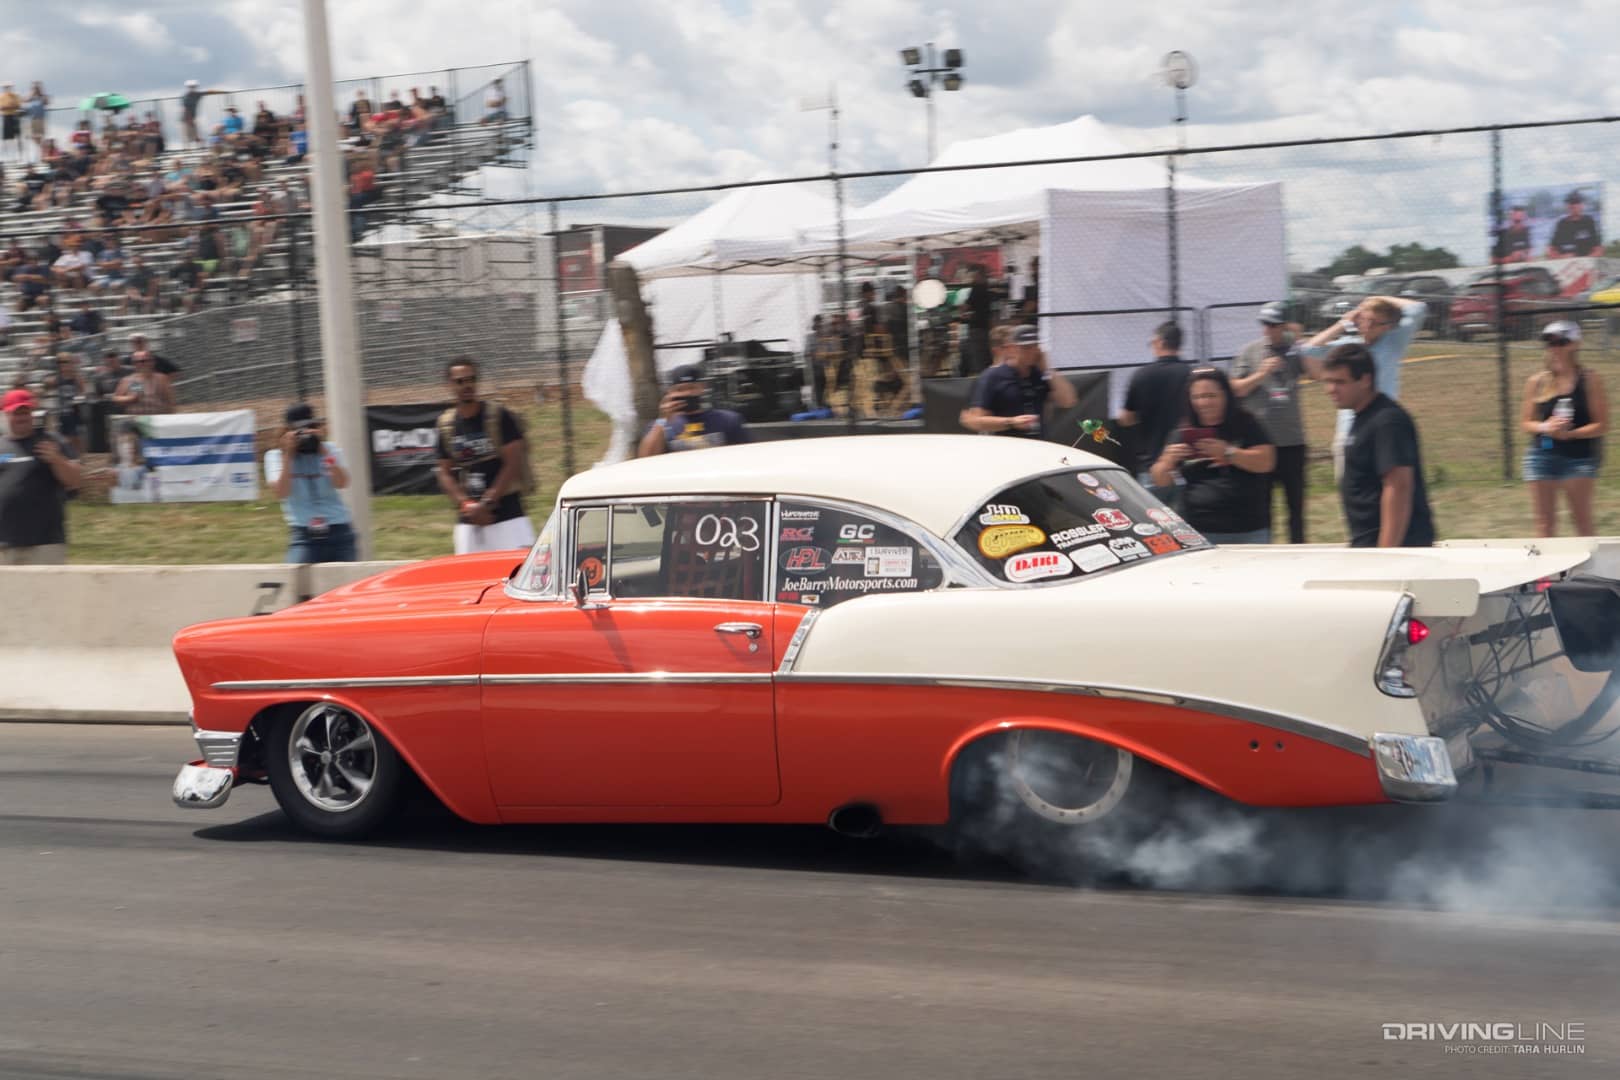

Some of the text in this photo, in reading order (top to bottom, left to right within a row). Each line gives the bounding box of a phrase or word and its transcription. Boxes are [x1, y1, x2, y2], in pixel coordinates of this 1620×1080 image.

[696, 514, 760, 551] 023
[840, 524, 875, 539] GC
[1050, 524, 1106, 544] ROSSLER
[786, 548, 825, 568] HPL
[782, 577, 918, 593] JoeBarryMotorsports.com
